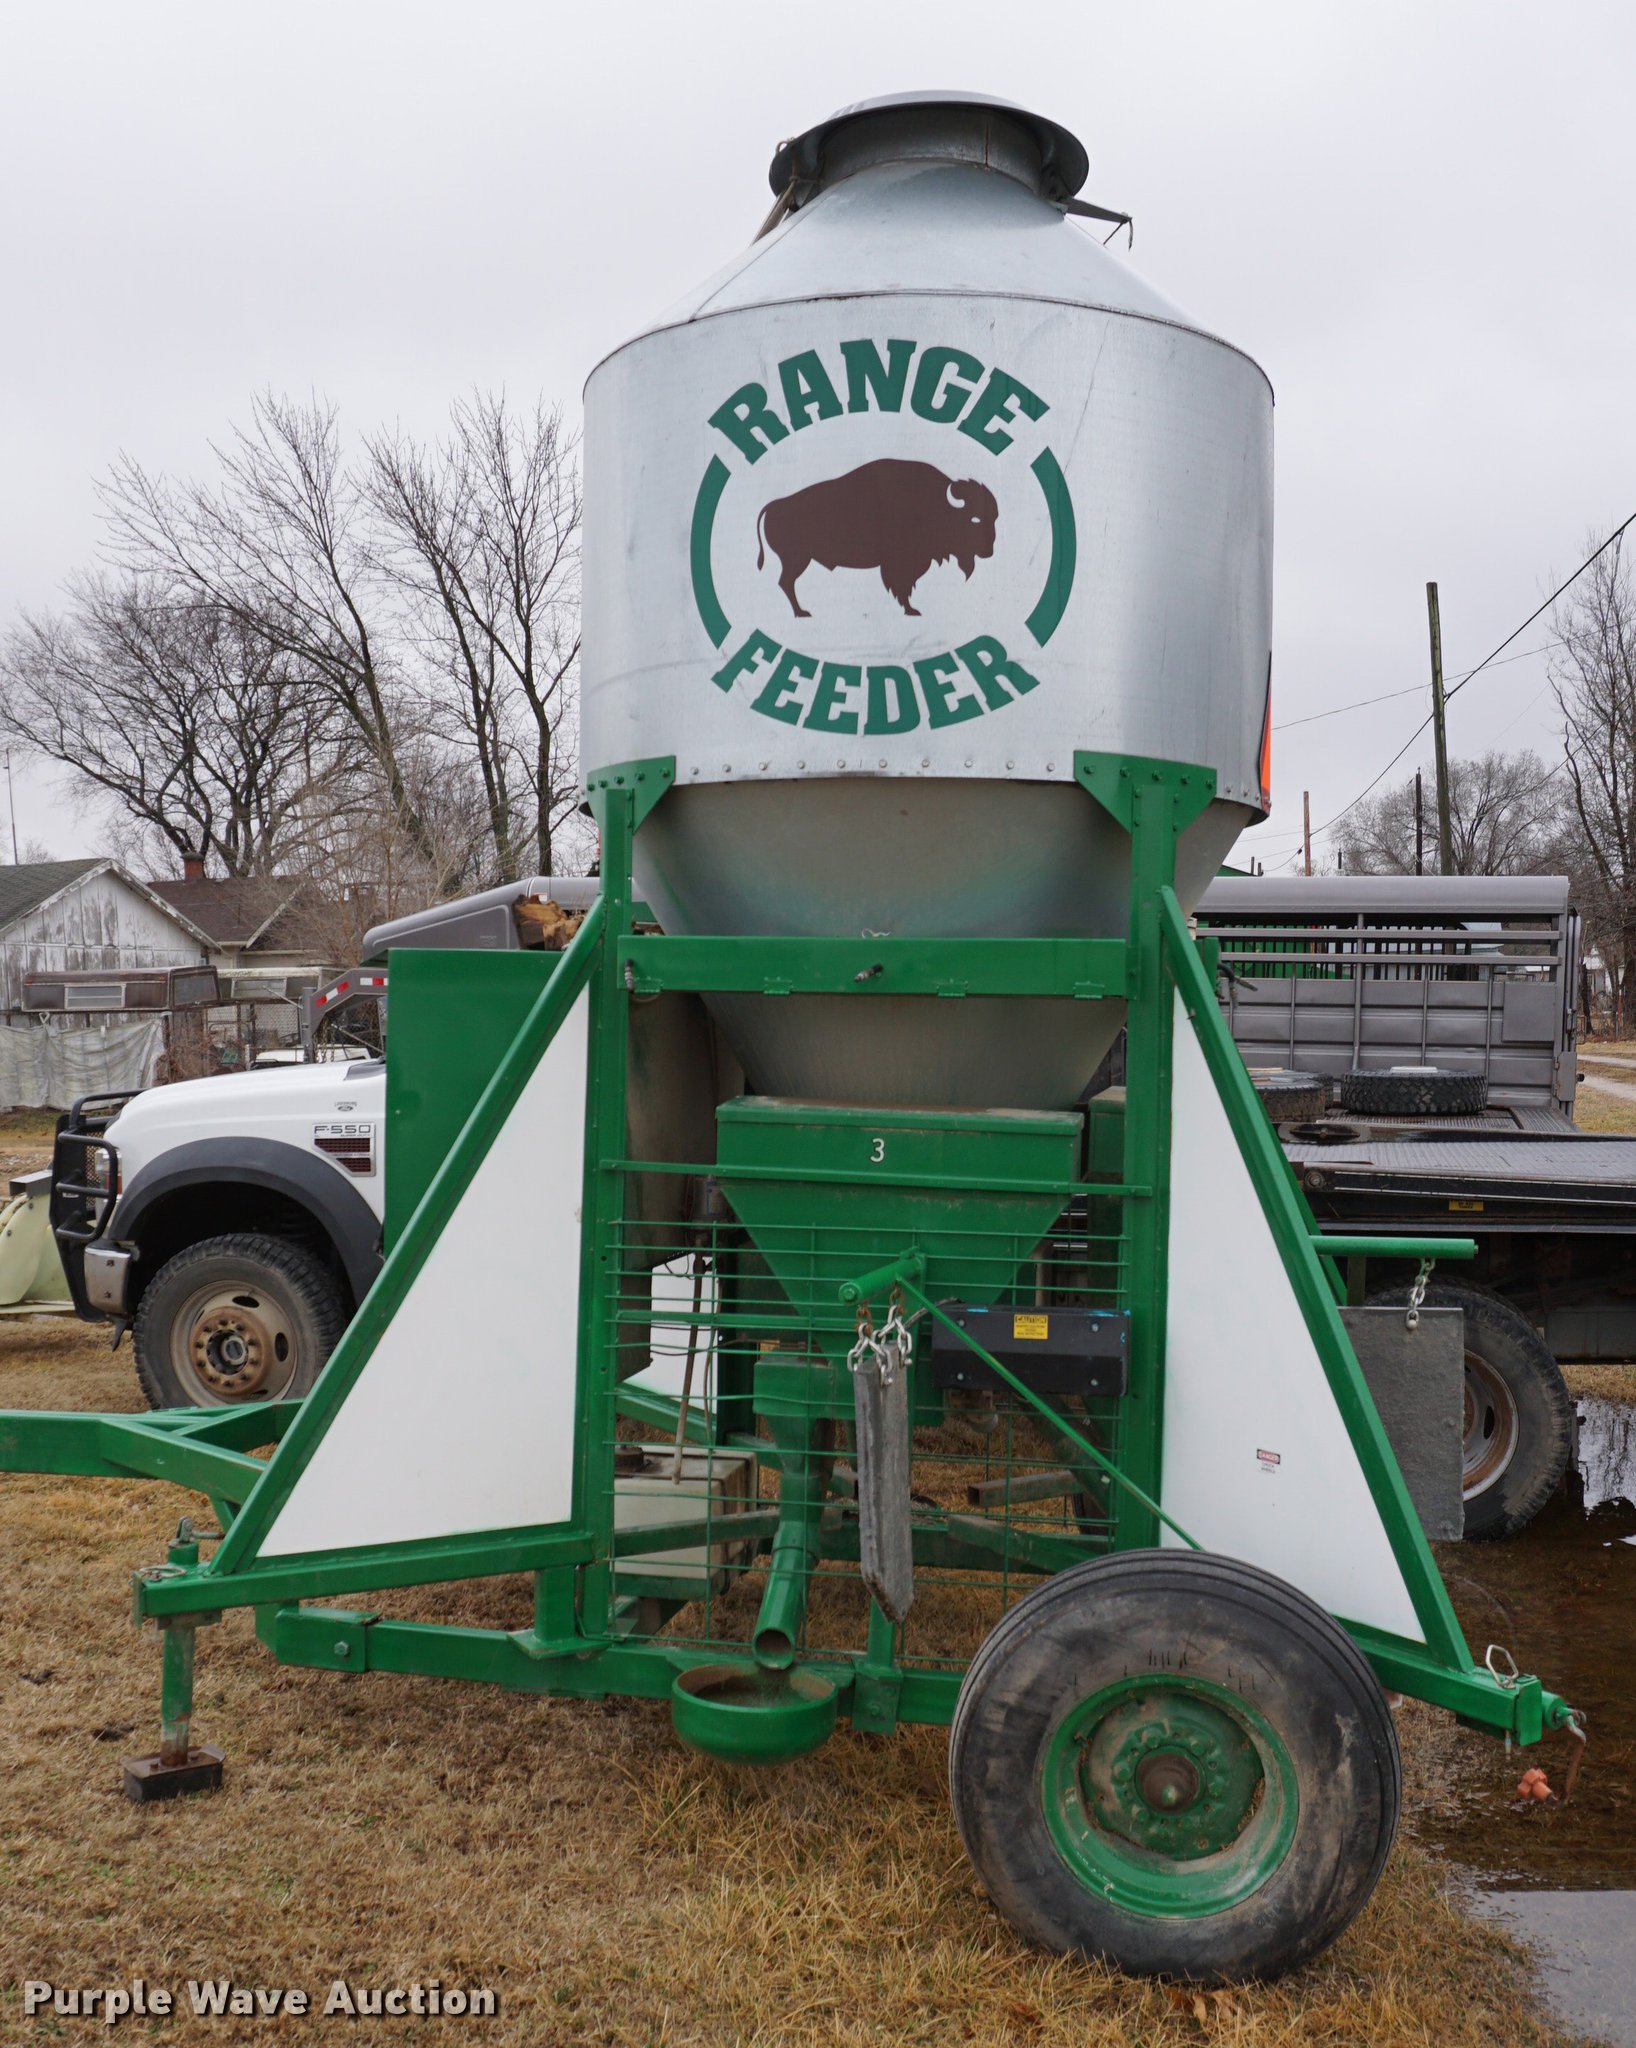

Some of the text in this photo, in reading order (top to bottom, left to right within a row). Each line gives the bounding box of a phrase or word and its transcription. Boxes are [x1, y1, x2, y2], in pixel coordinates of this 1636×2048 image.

[707, 338, 1051, 466] RANGE
[710, 628, 1041, 736] FEEDER
[870, 1137, 885, 1162] 3
